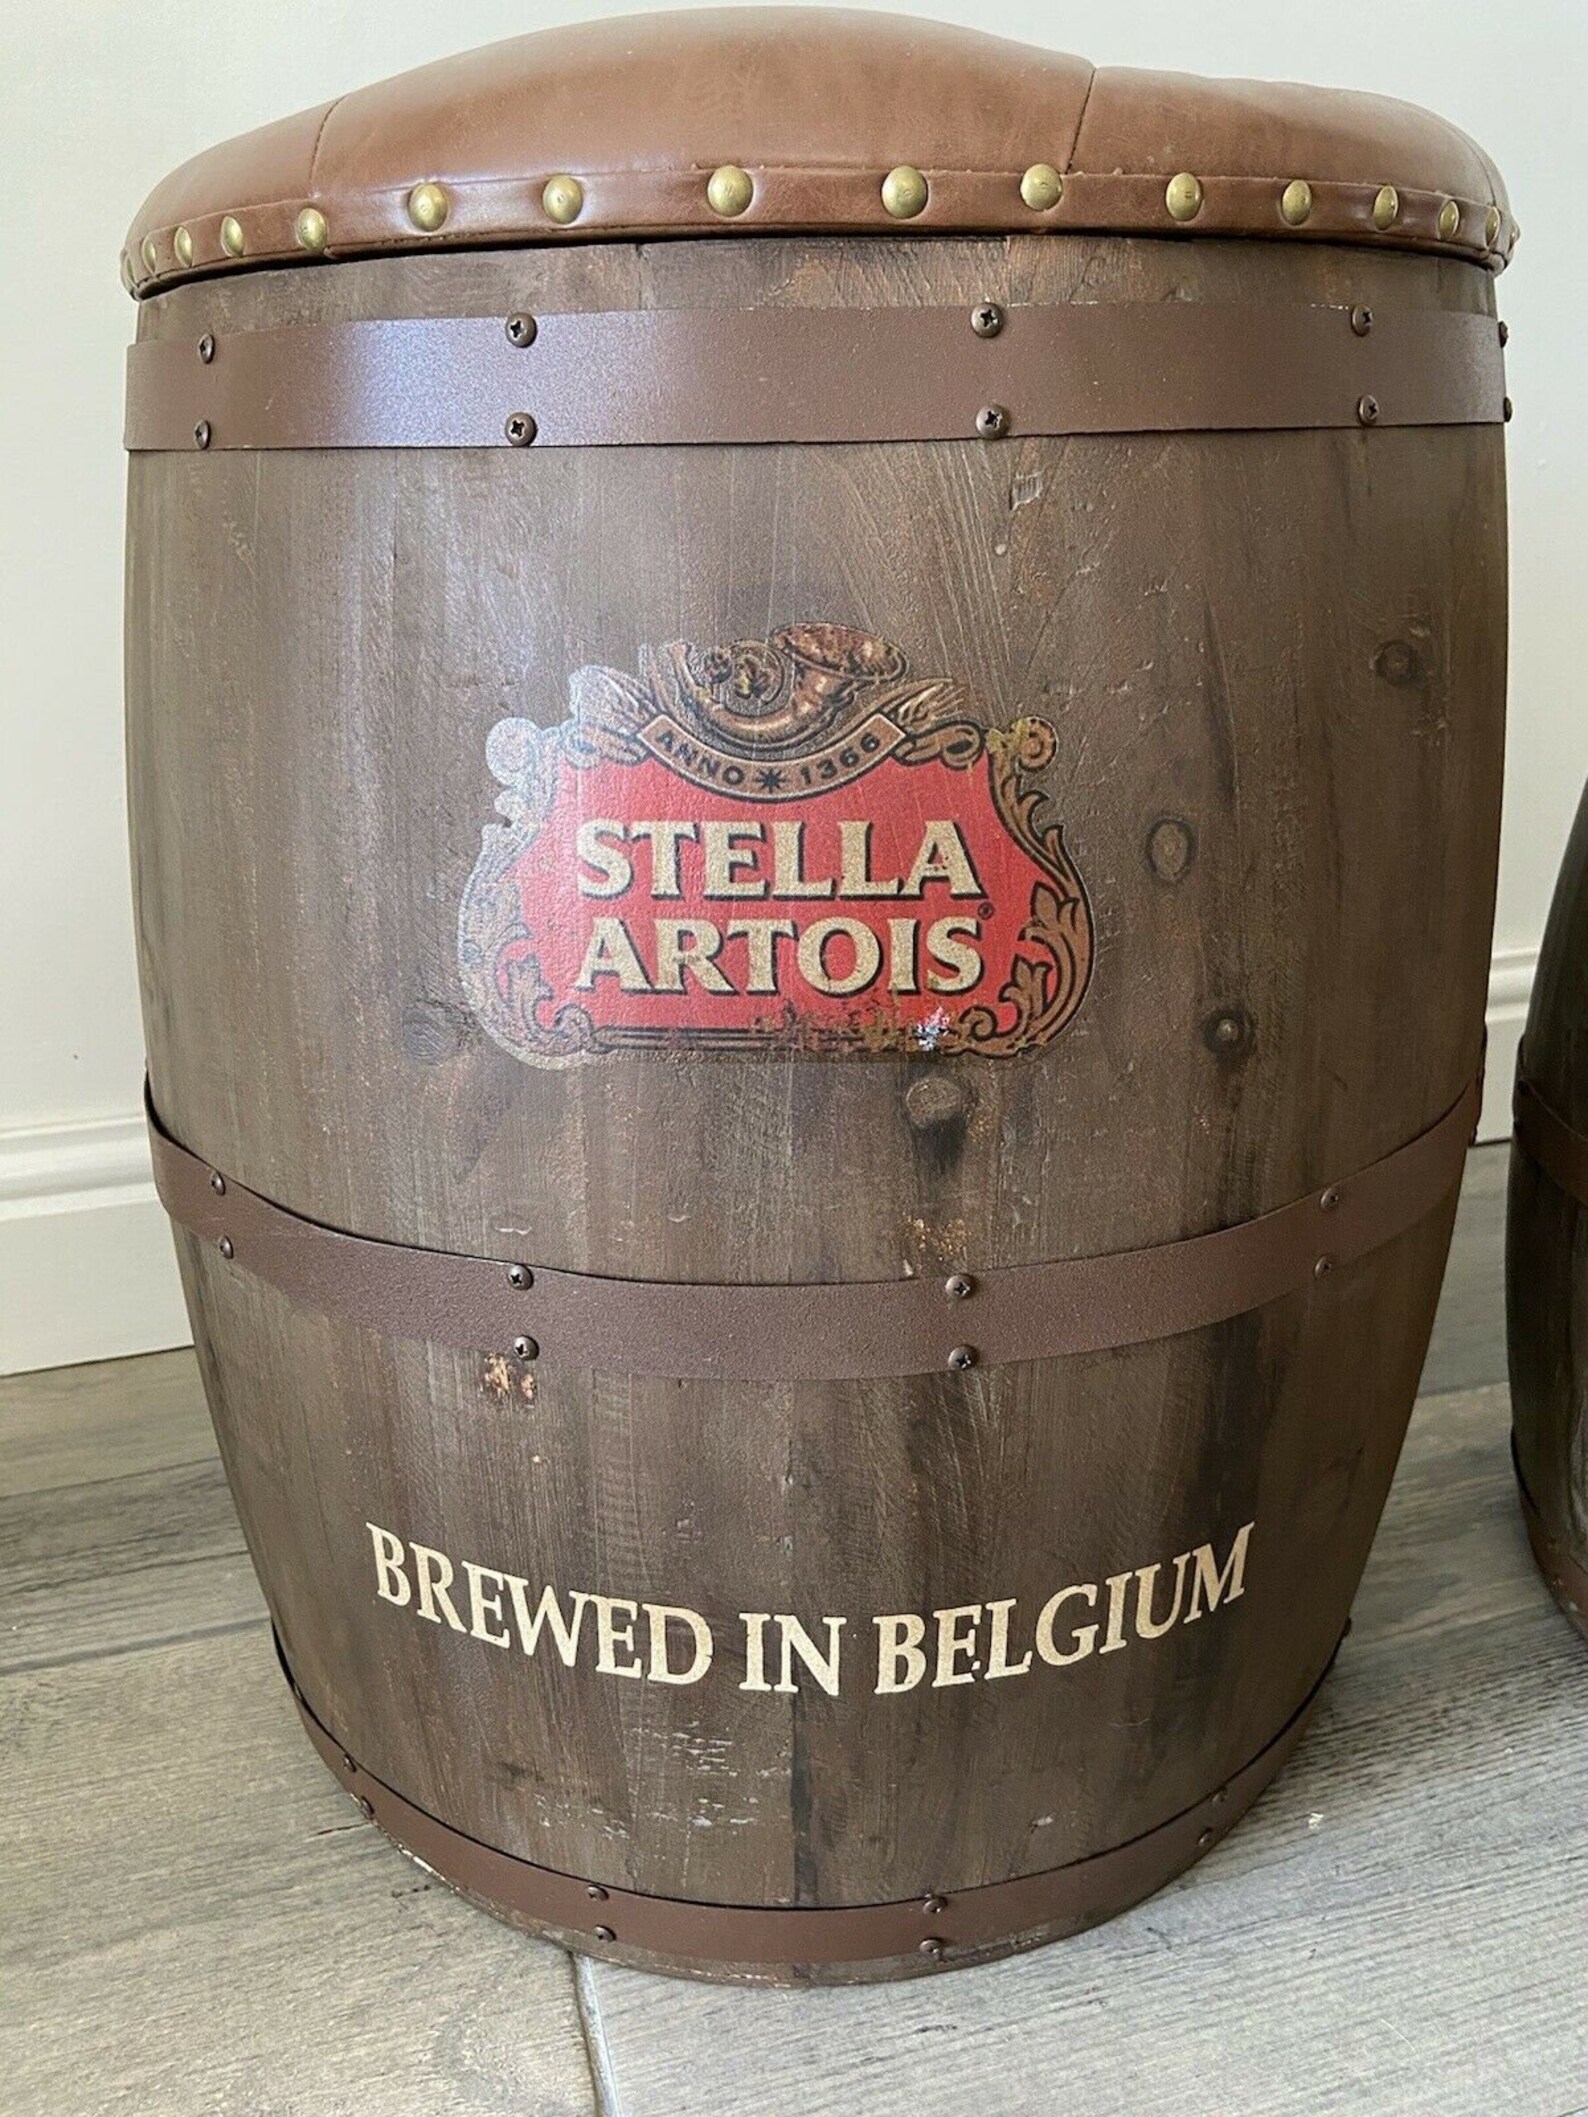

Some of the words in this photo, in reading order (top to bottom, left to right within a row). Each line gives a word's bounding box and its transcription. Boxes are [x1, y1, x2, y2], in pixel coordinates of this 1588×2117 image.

[654, 731, 743, 786] ANNO
[800, 731, 882, 787] 1366
[574, 818, 986, 901] STELLA
[573, 916, 988, 996] ARTOIS
[365, 1521, 713, 1687] BREWED
[738, 1611, 848, 1696] IN
[872, 1521, 1256, 1696] BELGIUM
